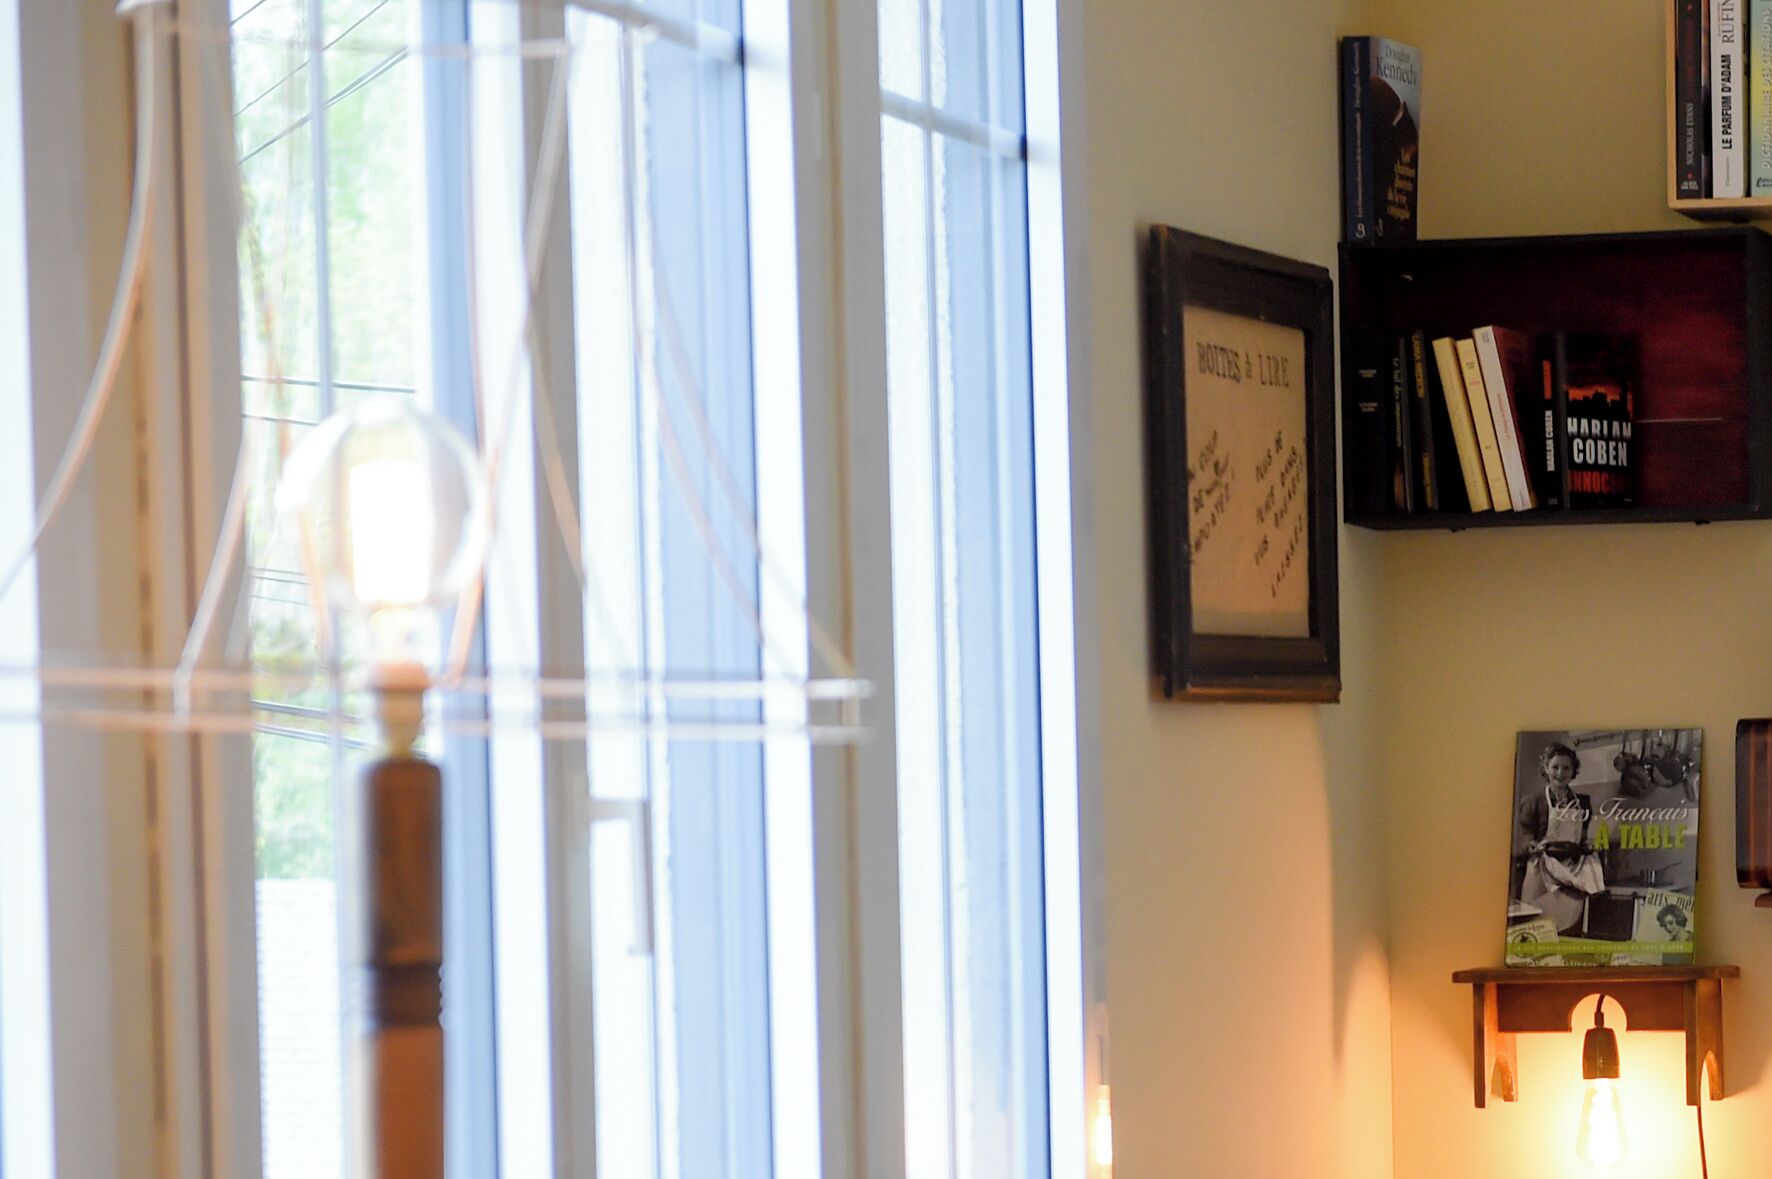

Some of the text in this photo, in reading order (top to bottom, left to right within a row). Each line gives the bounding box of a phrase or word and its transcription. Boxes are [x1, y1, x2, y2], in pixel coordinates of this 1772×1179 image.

[1759, 8, 1772, 63] CITATIONS
[1375, 54, 1418, 86] Kennedy
[1721, 54, 1732, 93] D'ADAM
[1721, 95, 1733, 136] PARFUM
[1760, 90, 1772, 169] DICTIONNAIRE
[1722, 138, 1733, 150] LE
[1566, 416, 1632, 440] HARLAN
[1572, 437, 1628, 467] COBEN
[1618, 823, 1688, 851] TABLE
